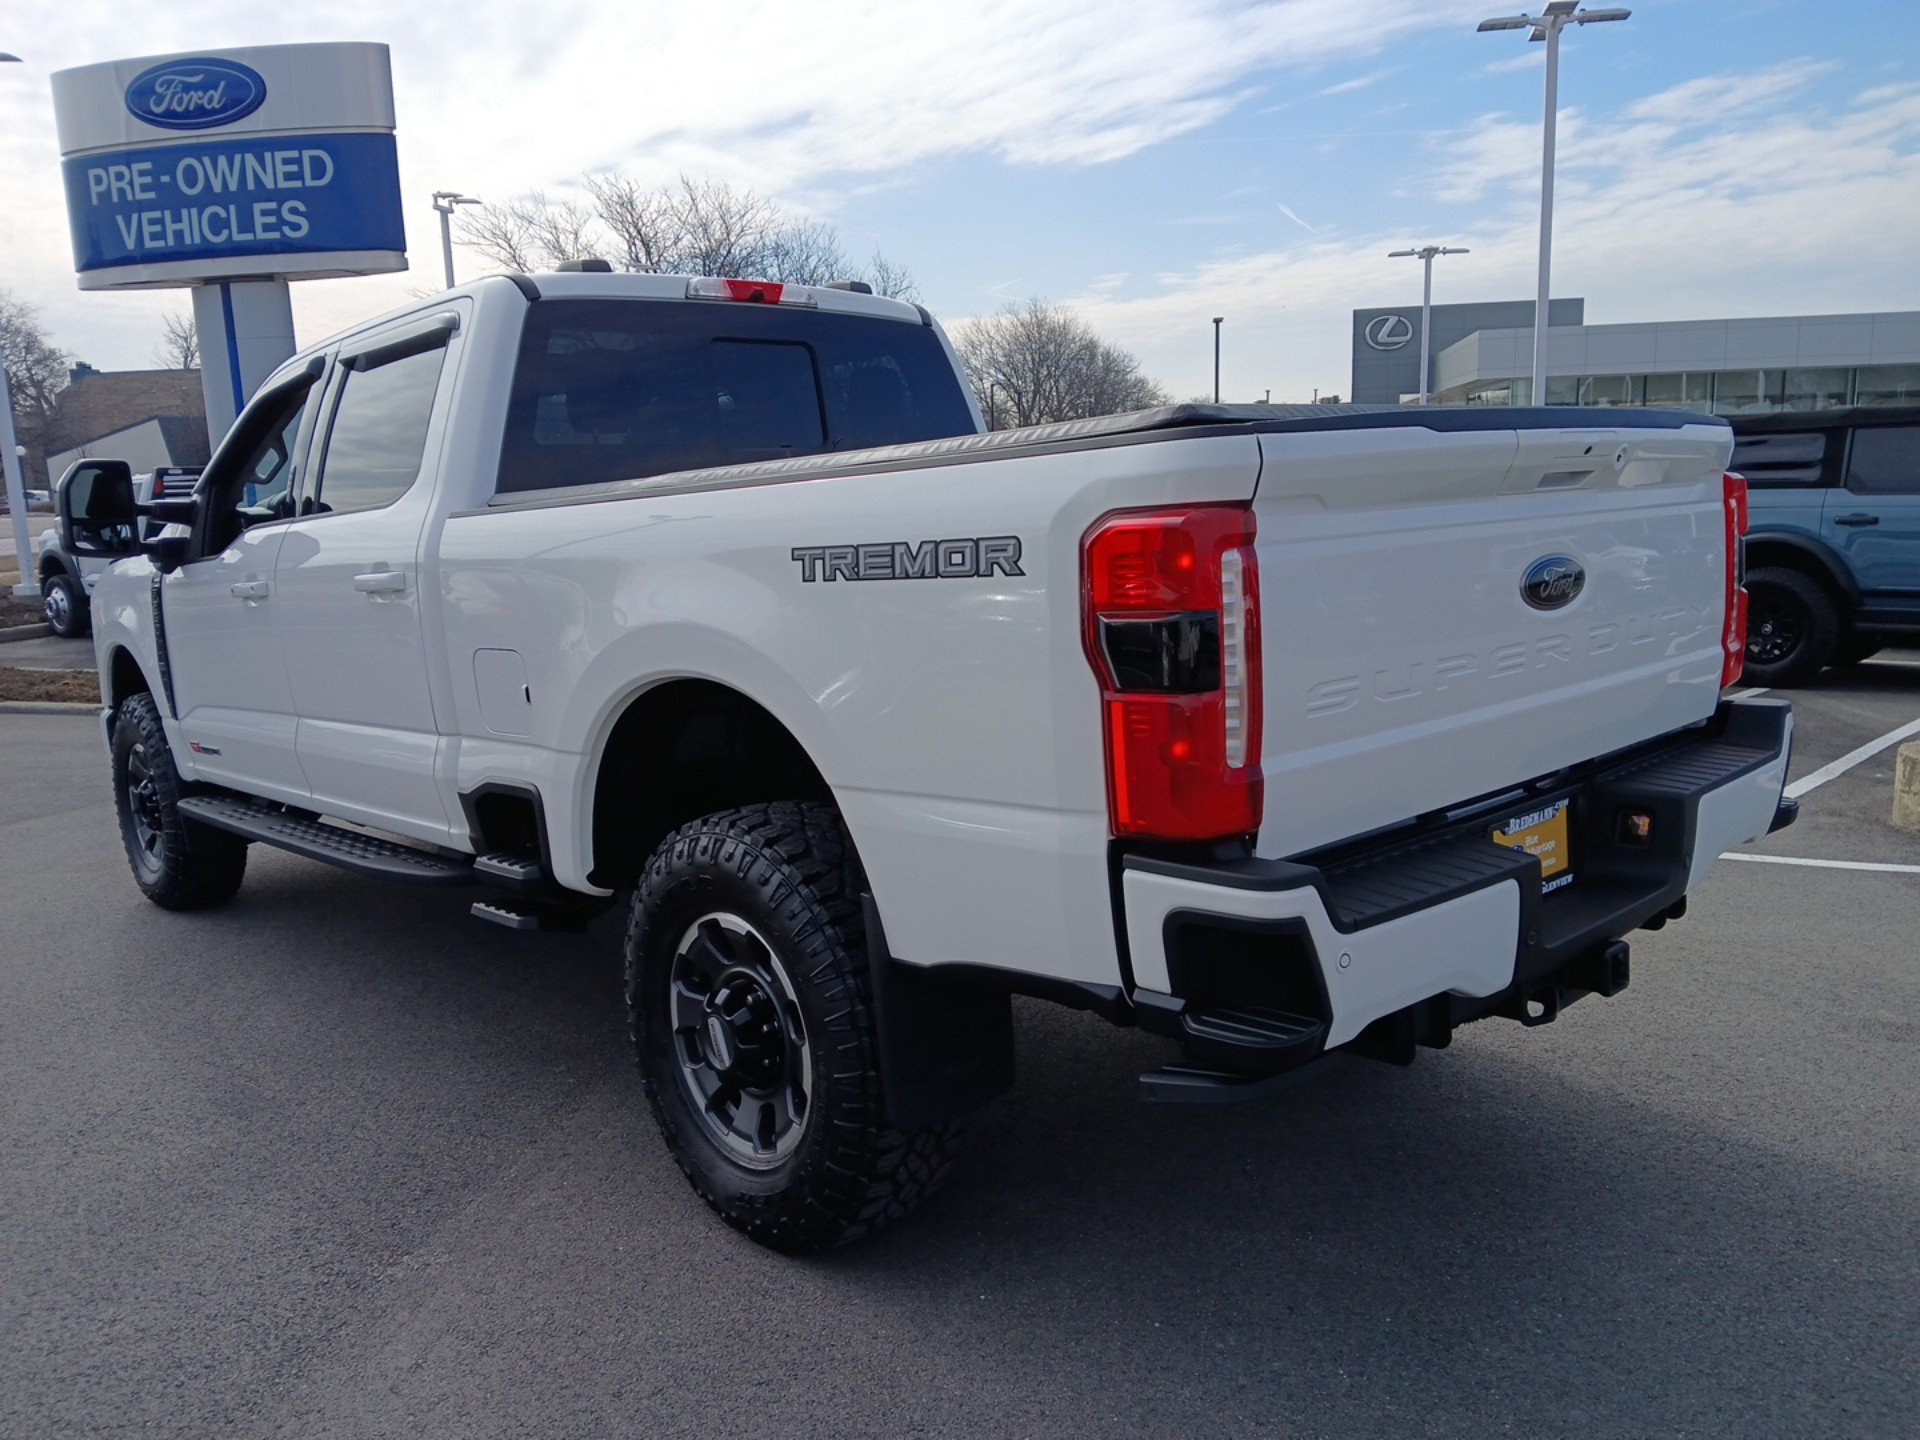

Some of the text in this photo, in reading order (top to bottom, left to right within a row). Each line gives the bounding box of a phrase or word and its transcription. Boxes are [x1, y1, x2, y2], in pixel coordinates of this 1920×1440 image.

[149, 74, 226, 113] Ford
[116, 200, 309, 250] VEHICLES
[791, 535, 1027, 582] TREMOR
[1540, 566, 1578, 598] Ford
[1307, 602, 1711, 719] SUPER DUTY
